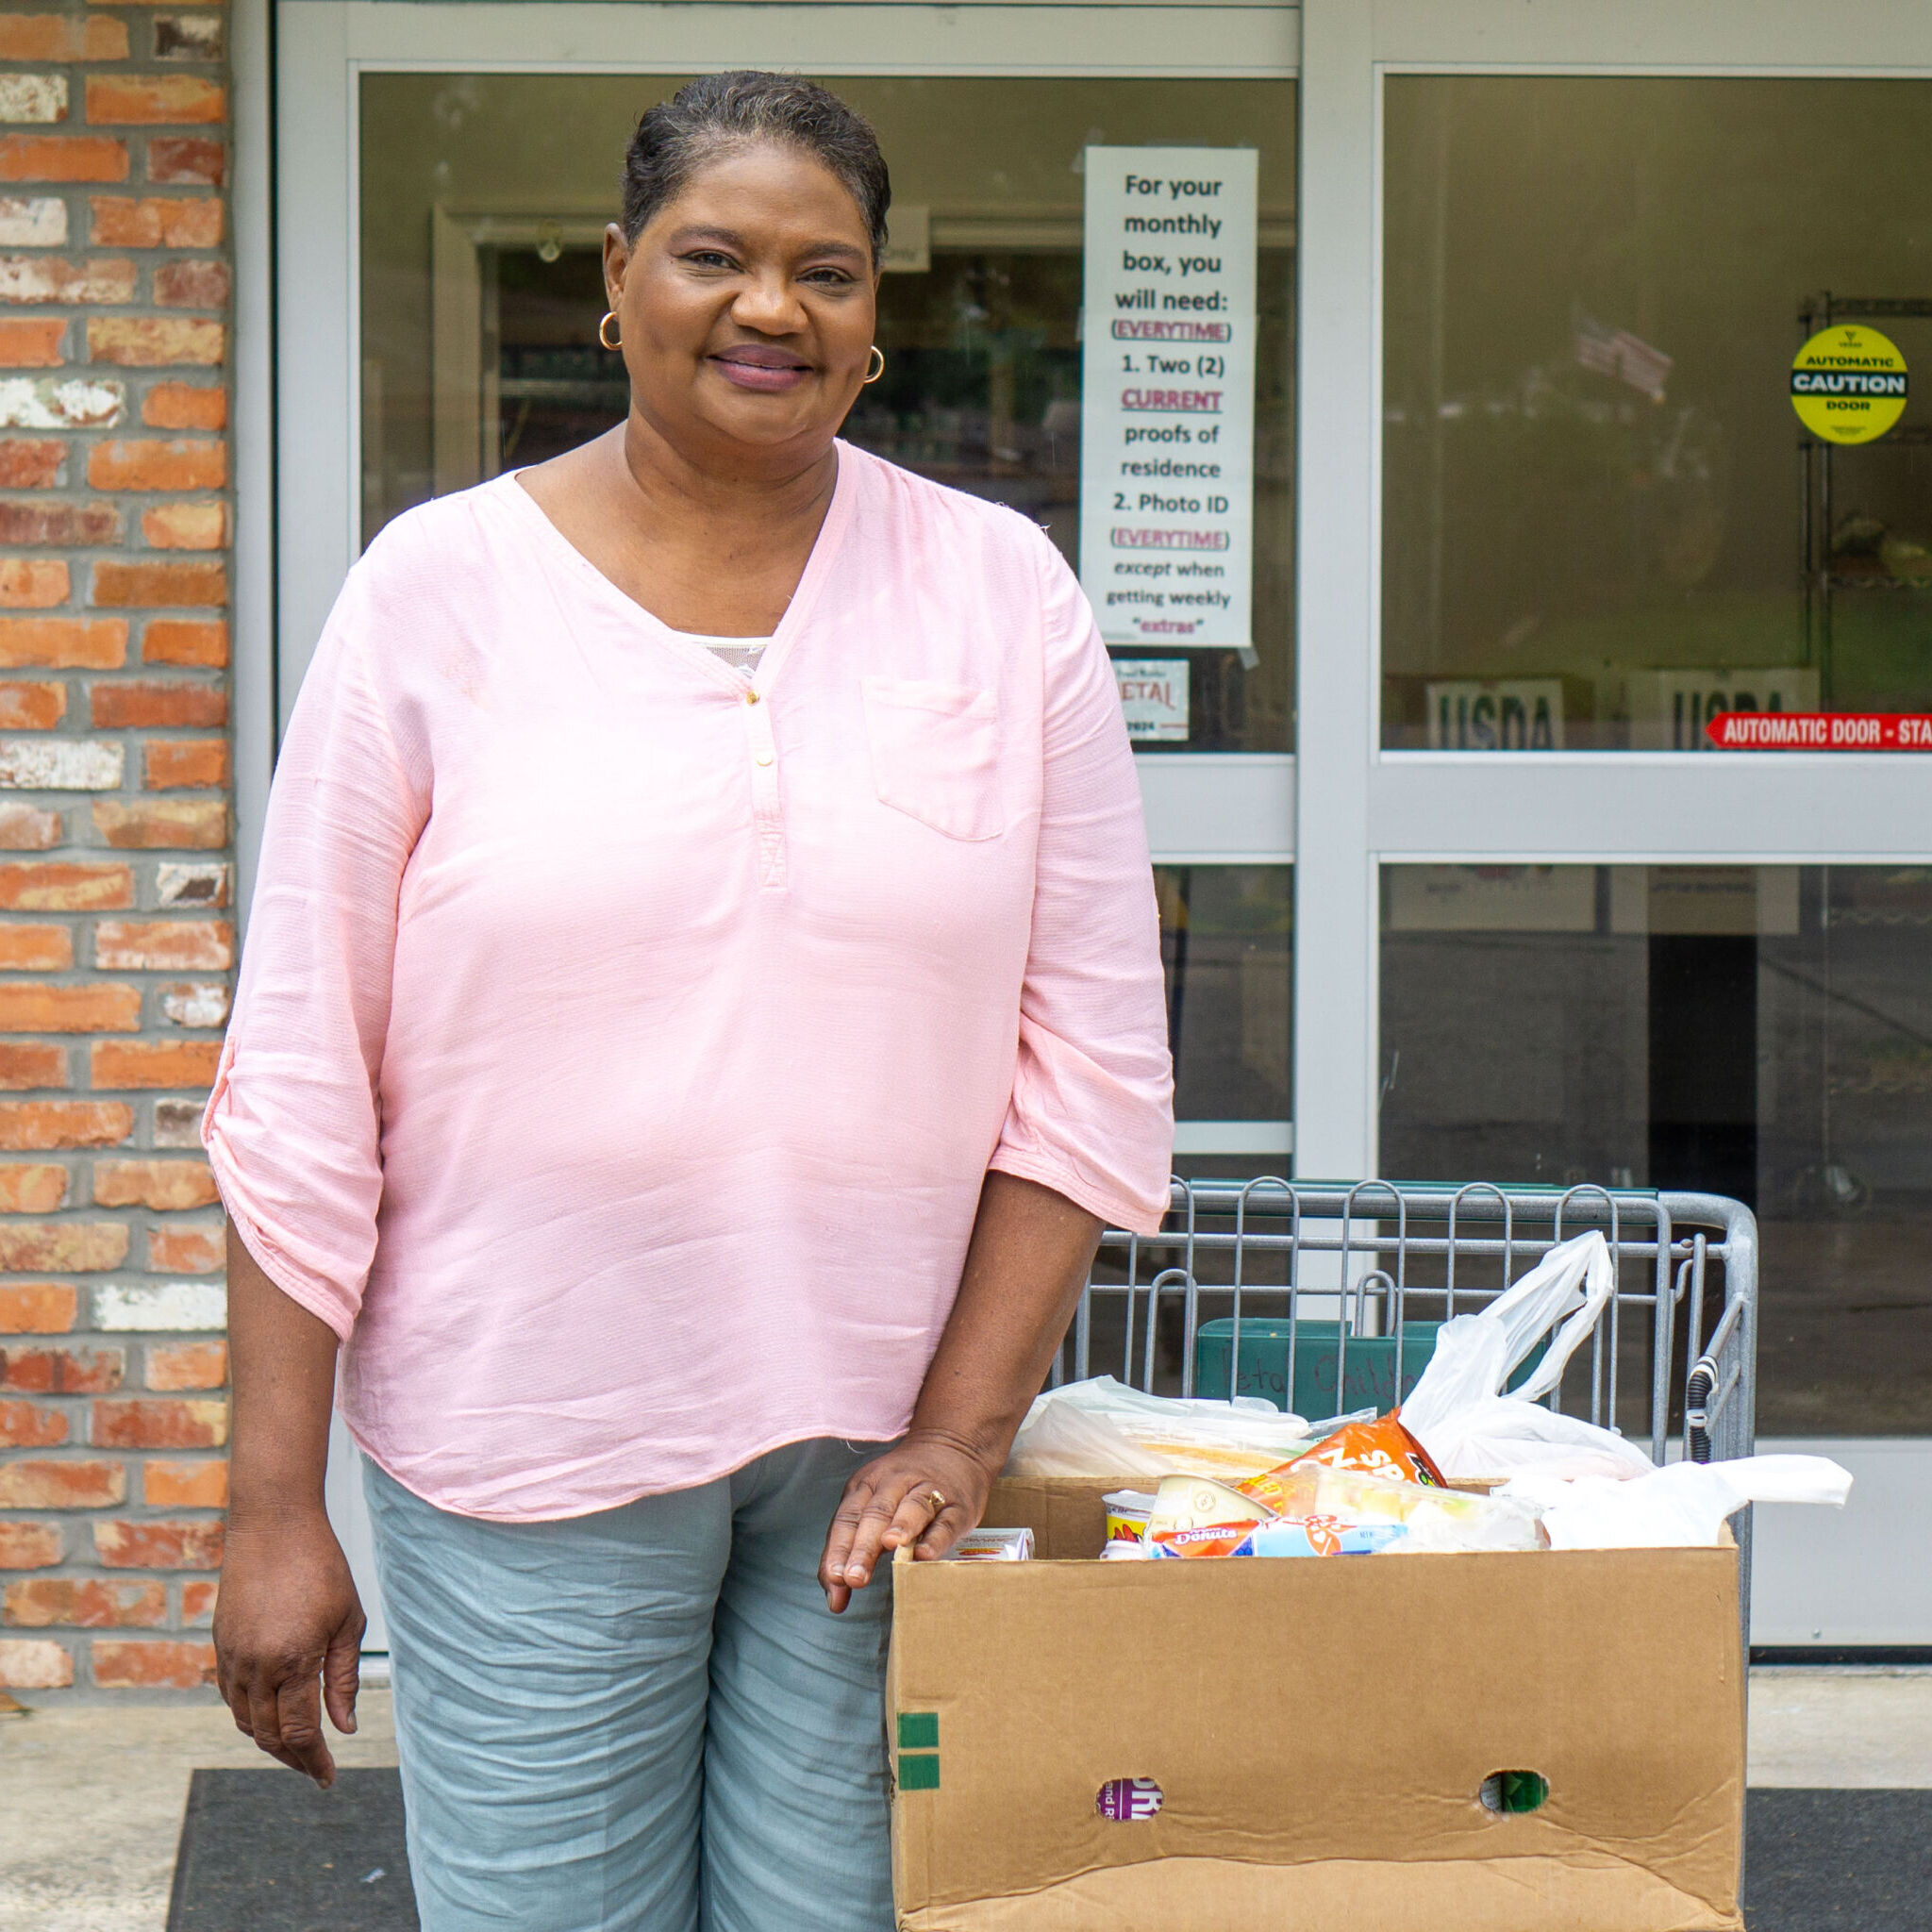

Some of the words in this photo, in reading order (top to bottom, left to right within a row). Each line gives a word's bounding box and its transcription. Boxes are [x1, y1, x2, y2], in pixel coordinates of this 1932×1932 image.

[1124, 174, 1163, 195] For
[1169, 179, 1224, 201] your
[1124, 213, 1223, 240] monthly
[1123, 249, 1172, 276] box,
[1178, 257, 1222, 277] you
[1114, 289, 1156, 310] will
[1162, 290, 1228, 311] need:
[1110, 318, 1233, 343] (EVERYTIME)
[1122, 354, 1141, 374] 1.
[1146, 354, 1191, 375] Two
[1196, 356, 1225, 379] (2)
[1806, 356, 1894, 368] AUTOMATIC
[1792, 373, 1906, 394] CAUTION
[1121, 388, 1224, 411] CURRENT
[1825, 400, 1871, 411] DOOR
[1124, 424, 1191, 446] proofs
[1197, 425, 1221, 444] of
[1121, 458, 1222, 478] residence
[1113, 492, 1132, 511] 2.
[1139, 492, 1201, 513] Photo
[1207, 495, 1229, 514] ID
[1108, 526, 1231, 553] (EVERYTIME)
[1113, 559, 1173, 579] except
[1176, 560, 1225, 578] when
[1106, 589, 1165, 608] getting
[1169, 590, 1231, 610] weekly
[1120, 680, 1176, 711] ETAL
[1723, 717, 1828, 744] AUTOMATIC
[1831, 718, 1882, 744] DOOR
[1174, 1527, 1239, 1545] Donuts
